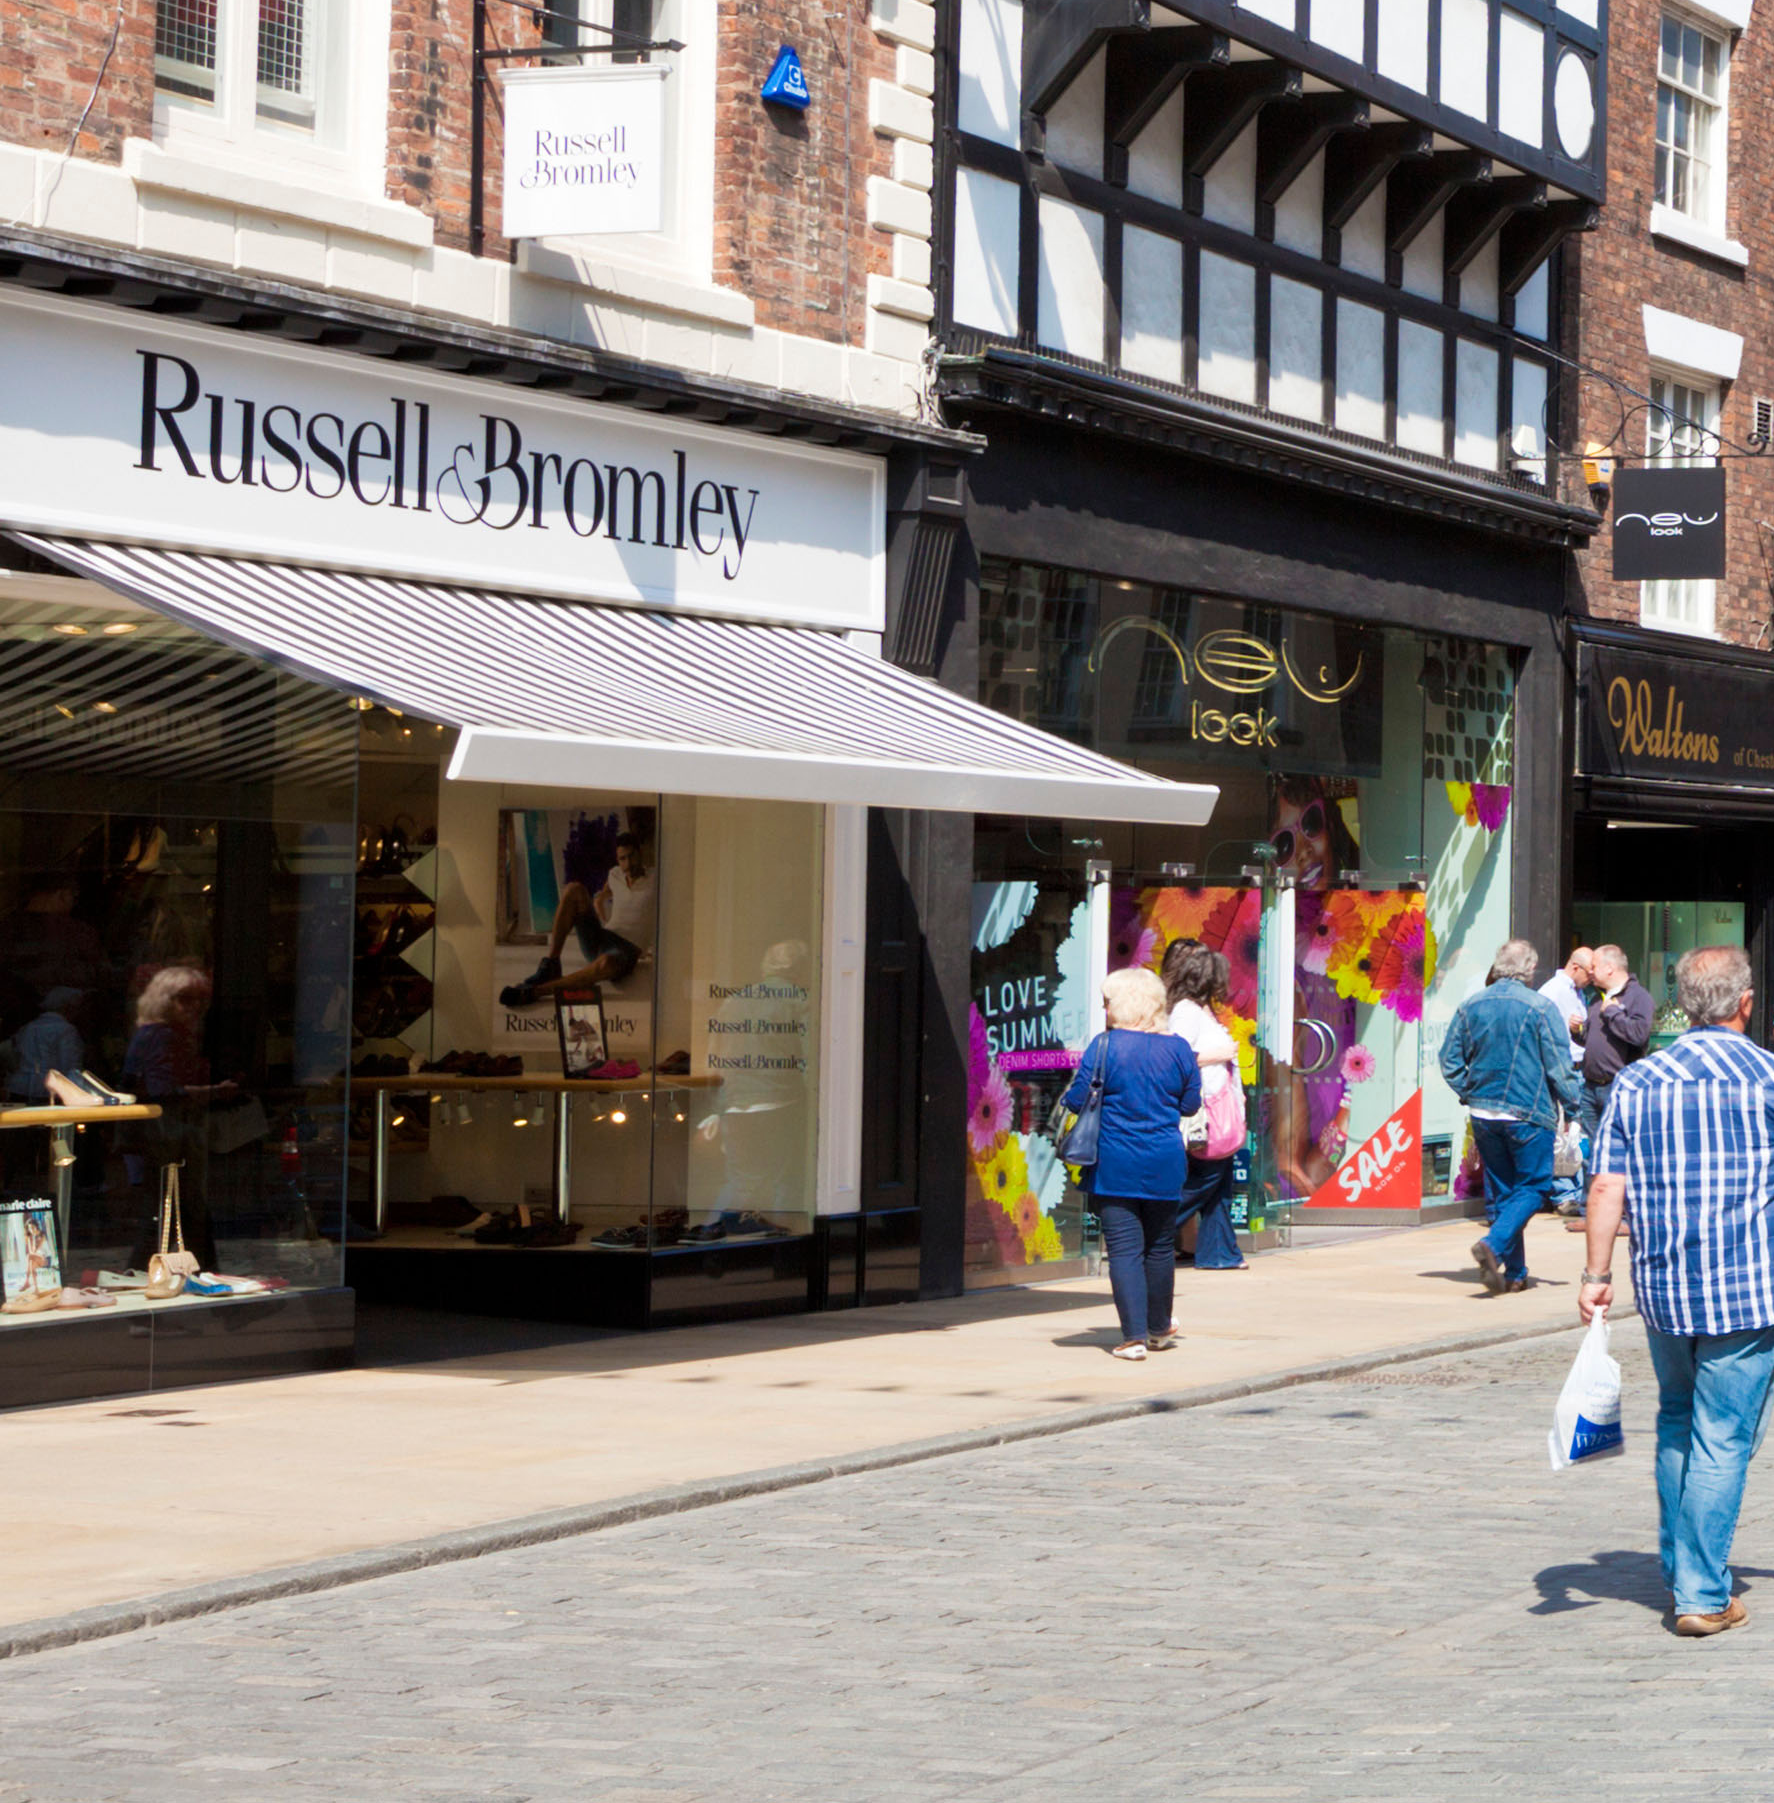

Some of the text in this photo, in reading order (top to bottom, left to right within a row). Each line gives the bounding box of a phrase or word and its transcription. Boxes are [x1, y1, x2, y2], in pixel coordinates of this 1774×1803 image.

[534, 125, 626, 157] Russell
[133, 348, 431, 513] Russell
[1650, 527, 1684, 537] look
[1190, 698, 1281, 748] look
[1606, 674, 1721, 764] Waltons
[1732, 747, 1745, 767] of
[709, 983, 753, 999] Russell
[985, 975, 1047, 1017] LOVE
[504, 1013, 557, 1034] Russel
[708, 1019, 752, 1034] Russell
[707, 1054, 752, 1069] Russell
[999, 1052, 1029, 1070] DENIM
[1031, 1050, 1067, 1068] SHORTS
[1338, 1118, 1414, 1203] SALE
[1374, 1159, 1407, 1193] NOW ON
[26, 1197, 52, 1210] claire
